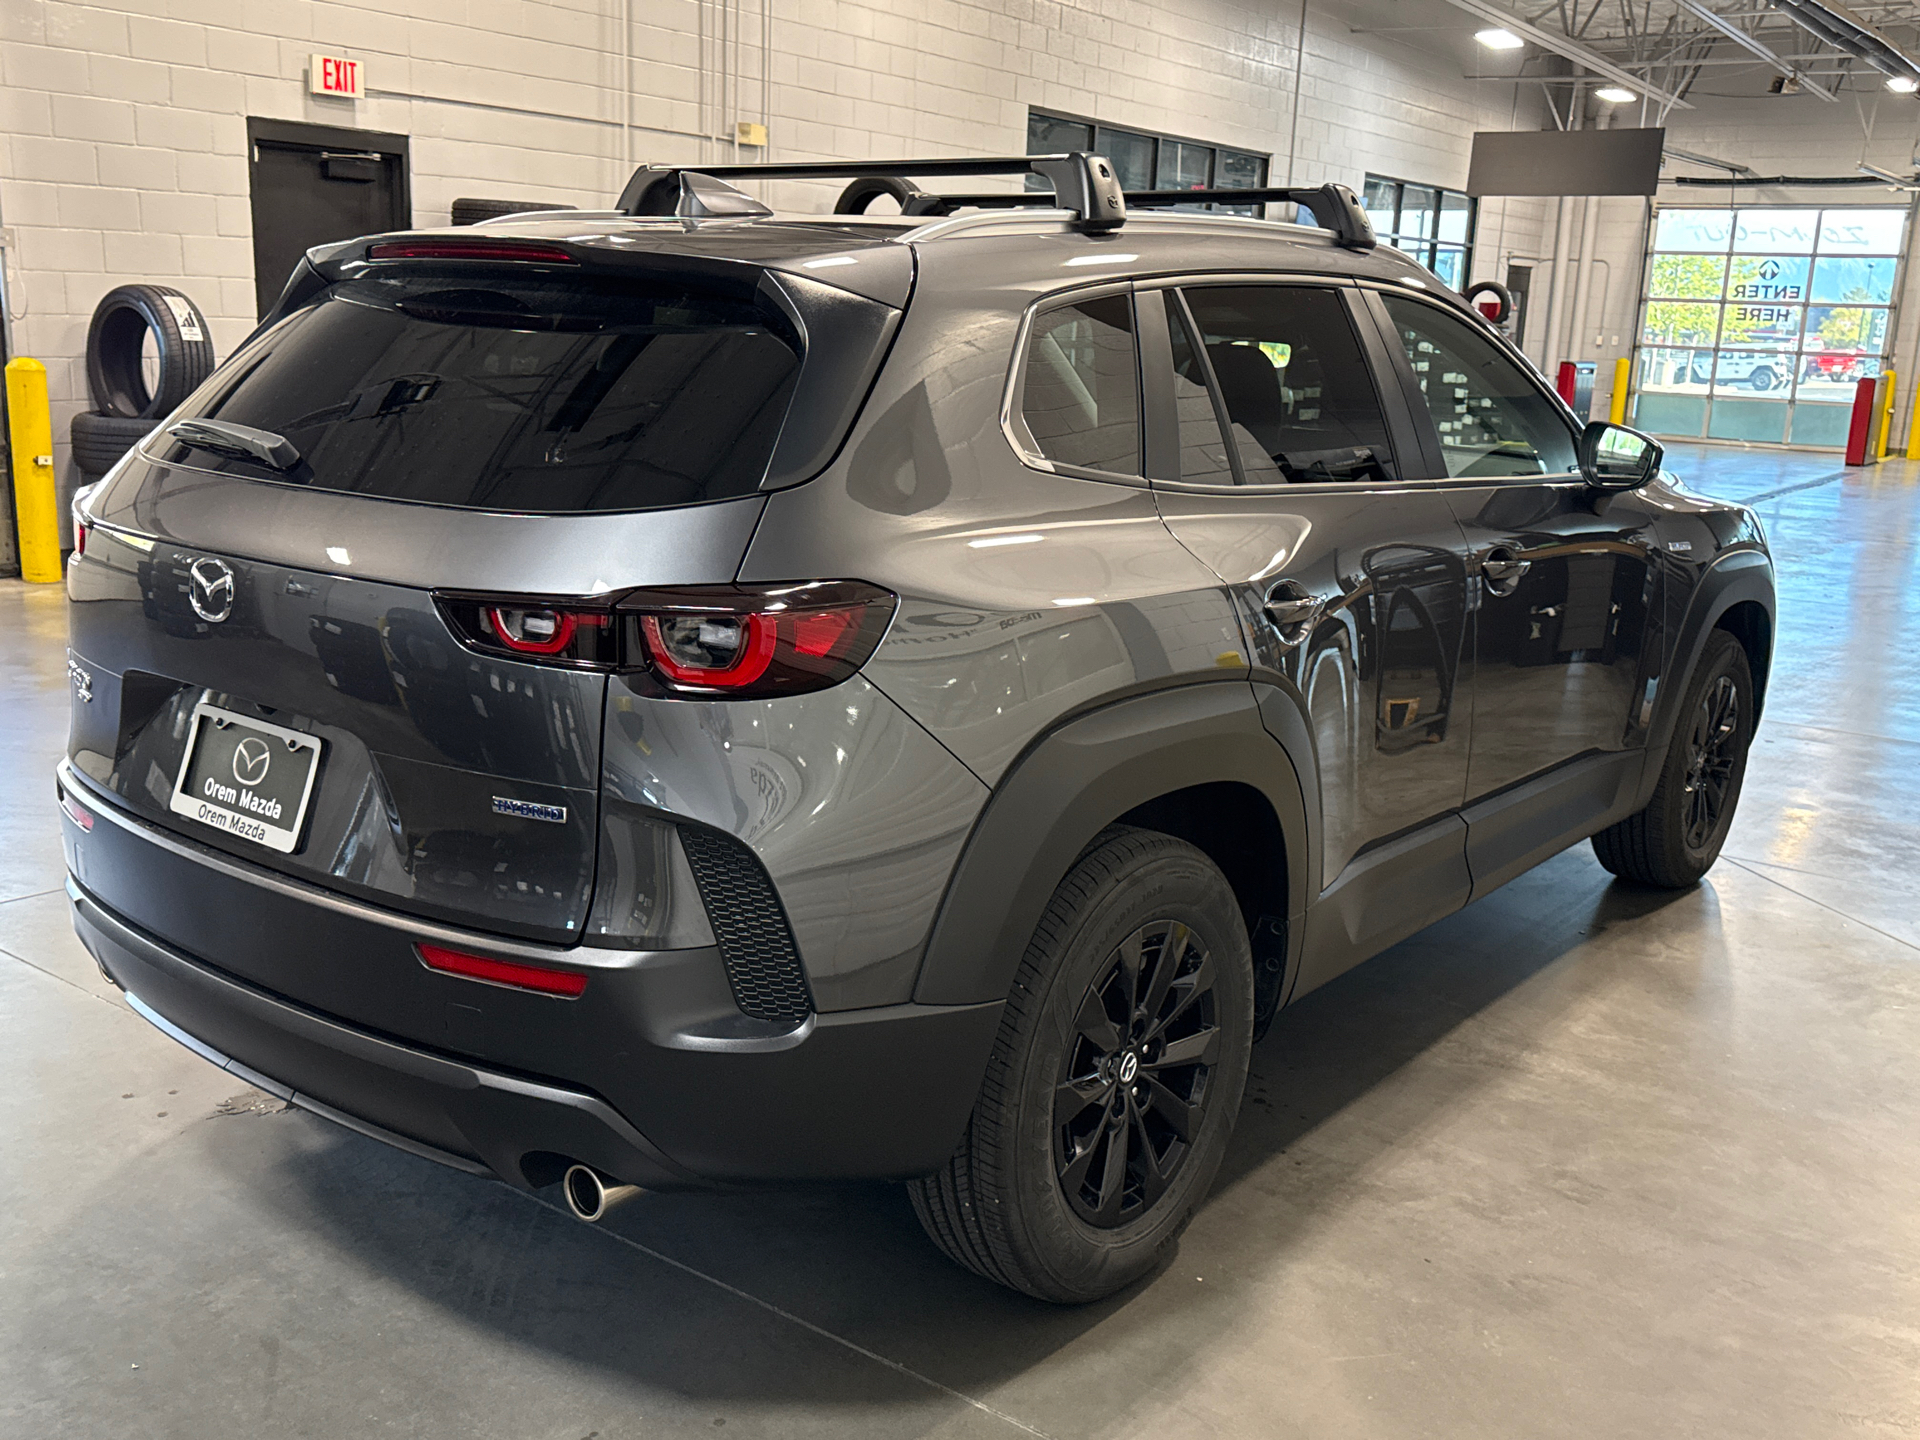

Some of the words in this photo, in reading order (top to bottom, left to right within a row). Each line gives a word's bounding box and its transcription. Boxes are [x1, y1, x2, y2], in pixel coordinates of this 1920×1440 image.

[322, 57, 357, 93] EXIT
[204, 777, 236, 804] Orem
[239, 789, 282, 819] Mazda
[497, 799, 563, 820] HYBRID
[198, 804, 227, 827] Orem
[229, 814, 266, 841] Mazda
